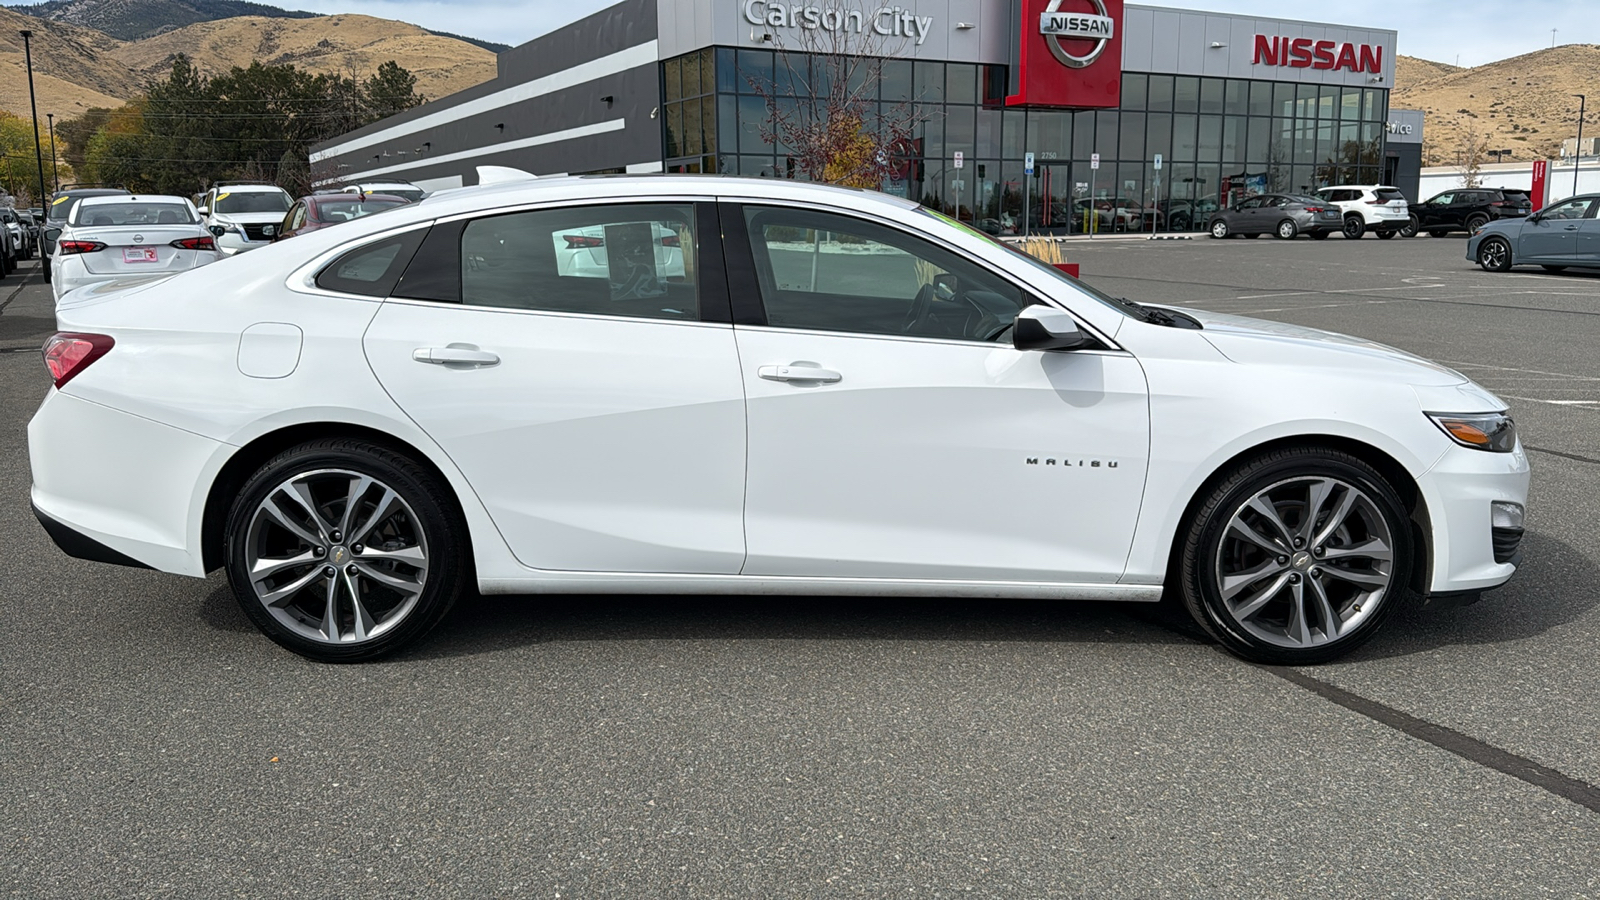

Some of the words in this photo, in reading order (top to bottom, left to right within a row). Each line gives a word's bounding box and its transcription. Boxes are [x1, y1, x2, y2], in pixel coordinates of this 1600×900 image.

[744, 0, 862, 33] Carson
[873, 6, 933, 45] City
[1050, 16, 1109, 34] NISSAN
[1254, 34, 1383, 74] NISSAN
[1390, 120, 1413, 135] vice
[1041, 152, 1057, 160] 2750
[1026, 457, 1119, 469] MALIBU
